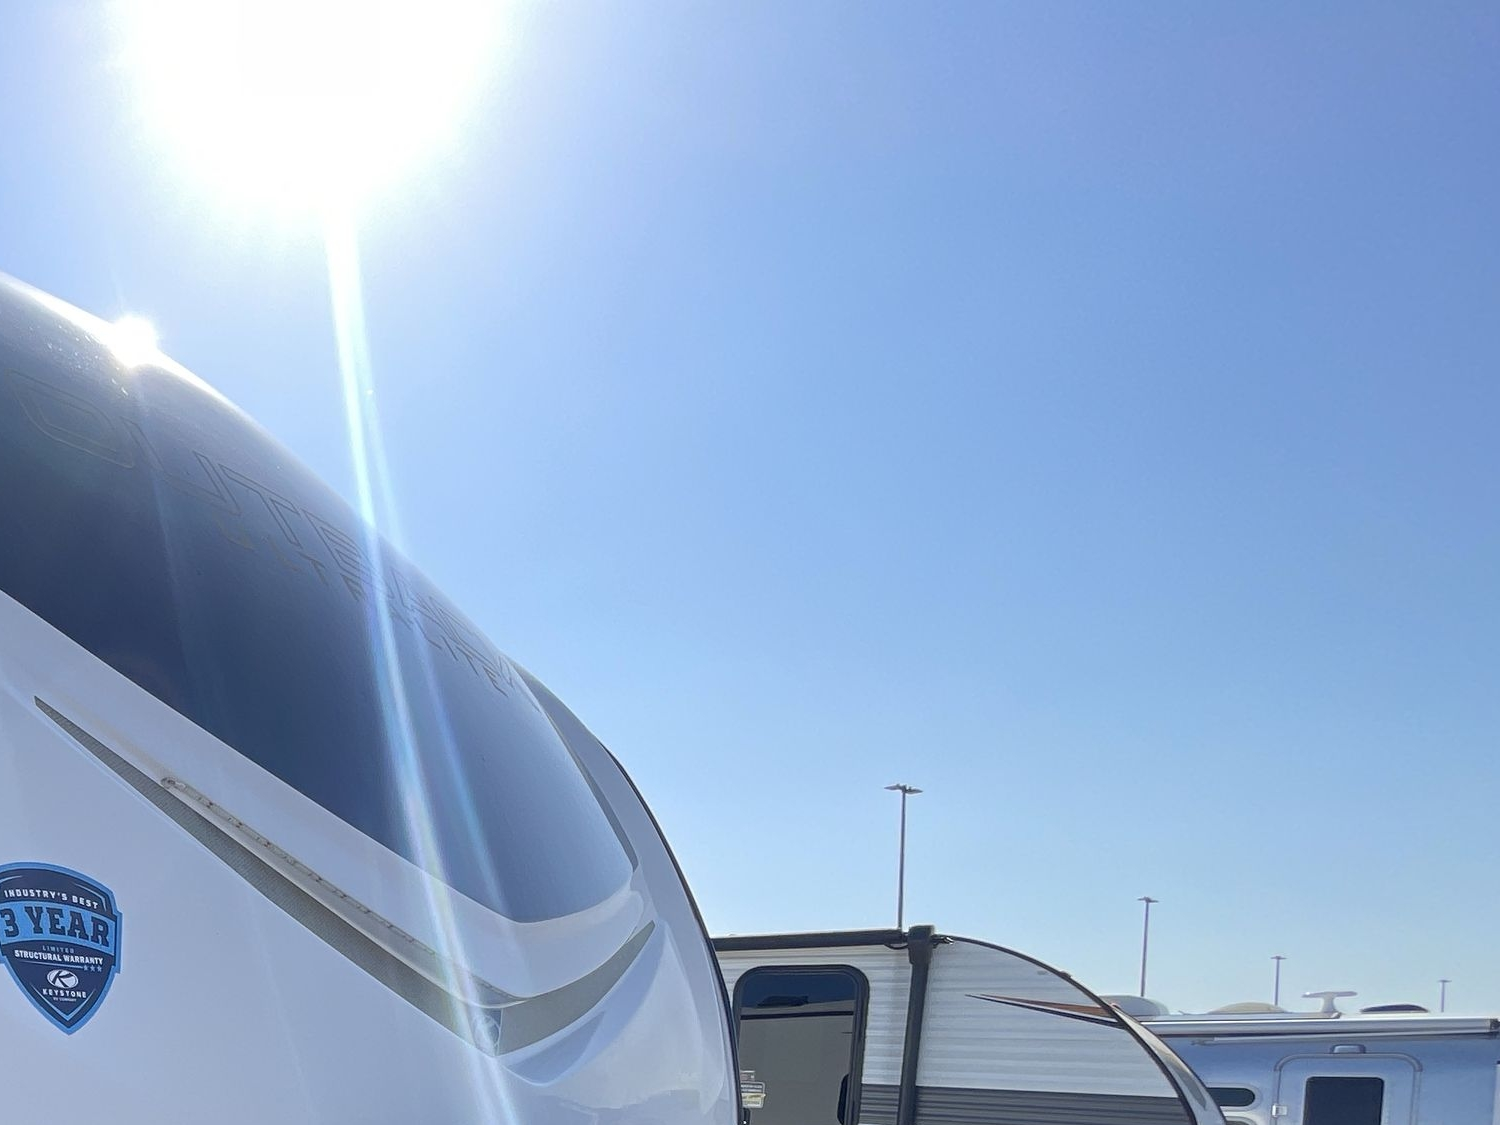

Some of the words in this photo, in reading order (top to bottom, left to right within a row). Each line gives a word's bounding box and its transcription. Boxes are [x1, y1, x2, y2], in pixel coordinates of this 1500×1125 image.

[4, 889, 68, 902] INDUSTRY'S
[72, 895, 99, 909] BEST
[0, 907, 20, 938] 3
[24, 906, 110, 948] YEAR
[42, 945, 75, 954] LIMITED
[14, 950, 62, 962] STRUCTURAL
[63, 954, 104, 966] WARRANTY
[42, 988, 87, 999] KEYSTONE
